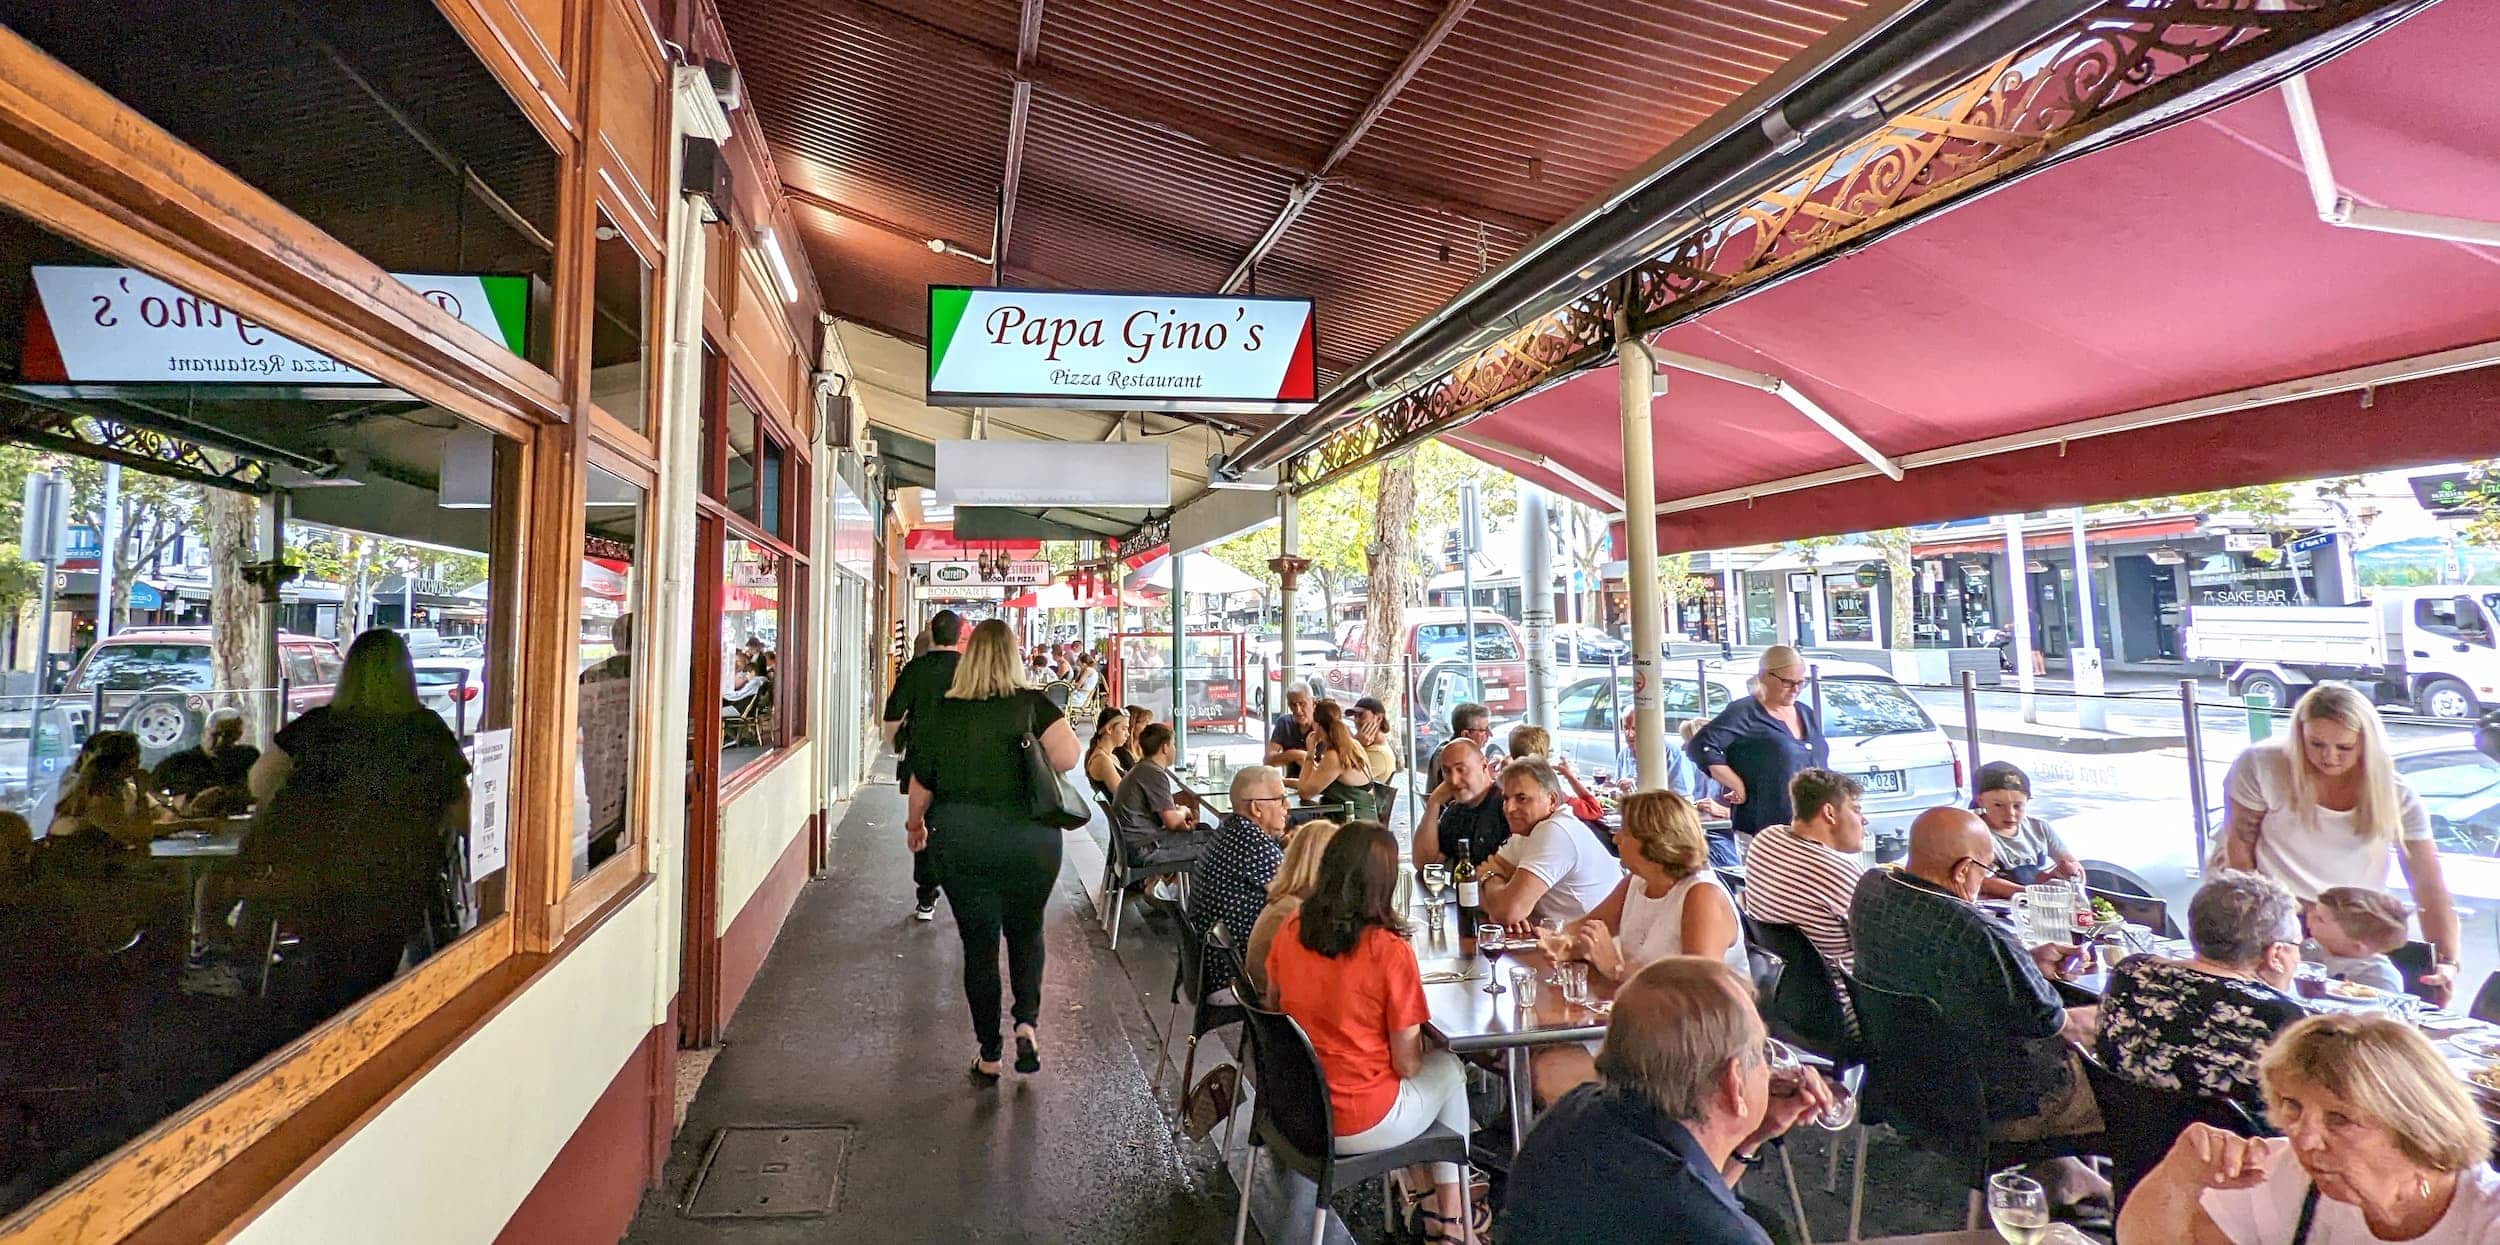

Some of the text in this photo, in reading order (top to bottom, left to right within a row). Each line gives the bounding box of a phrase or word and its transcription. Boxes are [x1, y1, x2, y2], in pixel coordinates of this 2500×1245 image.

[985, 306, 1265, 364] Papa Gino's
[1049, 368, 1203, 390] Pizza Restaurant
[928, 586, 991, 596] BONAPARTE
[2217, 589, 2286, 603] SAKE BAR
